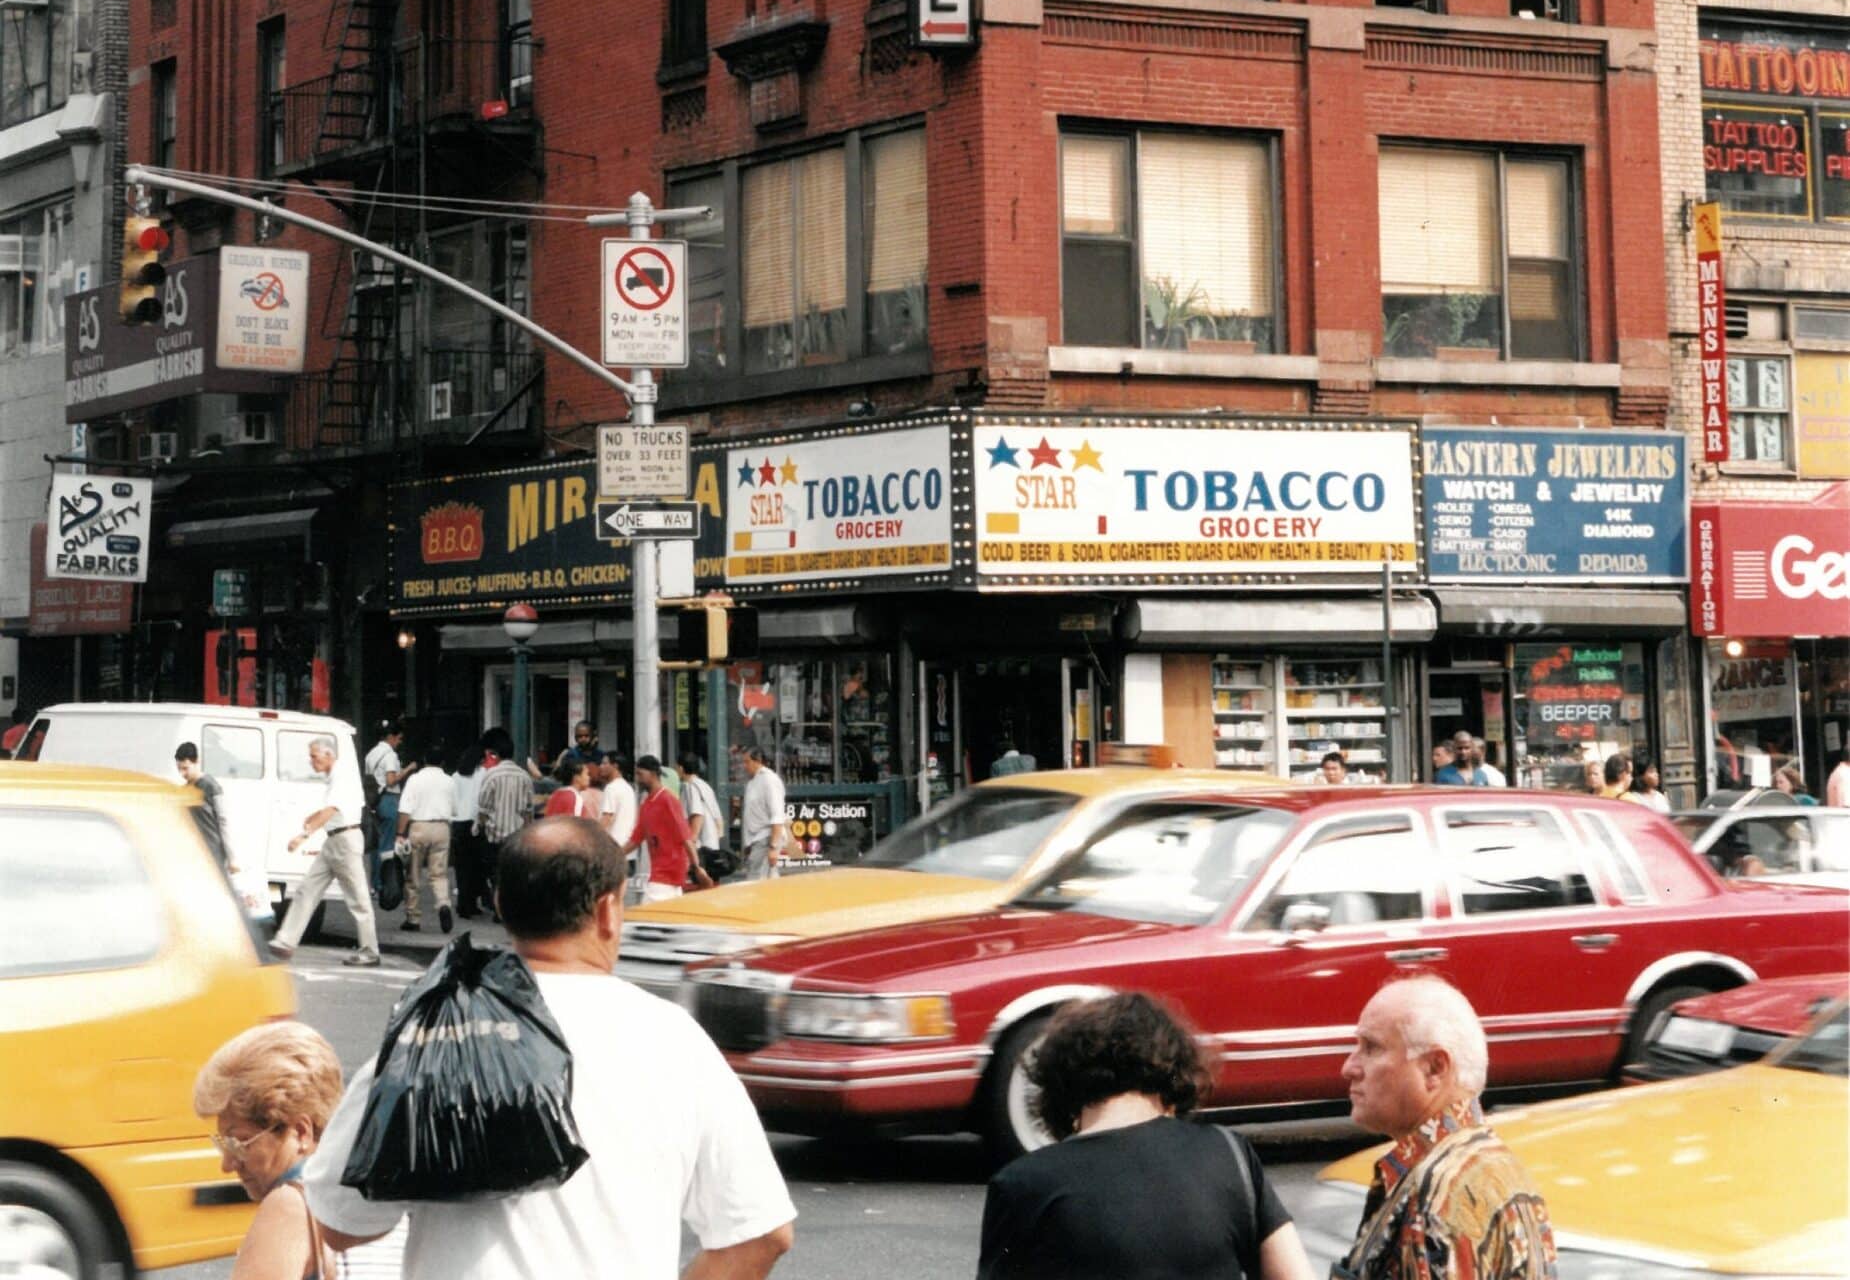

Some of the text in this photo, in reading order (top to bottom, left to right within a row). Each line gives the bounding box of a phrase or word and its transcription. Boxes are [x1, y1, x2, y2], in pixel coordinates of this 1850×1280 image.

[1708, 119, 1797, 149] TATTOO
[1703, 145, 1807, 177] SUPPLIES
[156, 331, 193, 353] QUALITY
[242, 332, 281, 345] THE BOX
[611, 330, 634, 339] MON
[662, 330, 679, 340] FRI
[72, 355, 104, 376] QUALITY
[1700, 260, 1723, 452] MENS WEAR
[605, 431, 683, 446] NO TRUCKS
[605, 450, 682, 461] OVER 33 FEET
[1423, 441, 1677, 479] EASTERN JEWELERS
[803, 468, 942, 520] TOBACCO
[1016, 475, 1077, 509] STAR
[1124, 470, 1386, 512] TOBACCO
[1443, 480, 1664, 503] WATCH & JEWELRY
[750, 492, 783, 525] STAR
[1437, 502, 1532, 515] ROLEX OMEGA
[1605, 508, 1632, 521] 14K
[63, 502, 140, 553] QUALITY
[616, 513, 689, 527] ONE WAY
[836, 520, 903, 539] GROCERY
[1200, 517, 1322, 538] GROCERY
[1437, 515, 1535, 527] SEIKO CITIZEN
[428, 524, 477, 554] B.B.Q.
[1438, 528, 1527, 539] TIMEX CASIO
[1584, 524, 1654, 538] DIAMOND
[982, 542, 1405, 562] COLD BEER & SODA CIGARETTES CIGARS CANDY HEALTH & BEAUTY ADS
[1439, 540, 1523, 551] BATTERY BAND
[56, 554, 139, 573] FABRICS
[1458, 554, 1648, 573] ELECTRONIC REPAIRS
[1771, 534, 1850, 600] Ge
[403, 564, 625, 599] FRESH JUICES MUFFINS B.B.Q. CHICKEN
[1699, 520, 1716, 631] GENERATIONS
[1541, 704, 1612, 722] BEEPER
[799, 804, 815, 819] Av
[819, 803, 867, 819] Station
